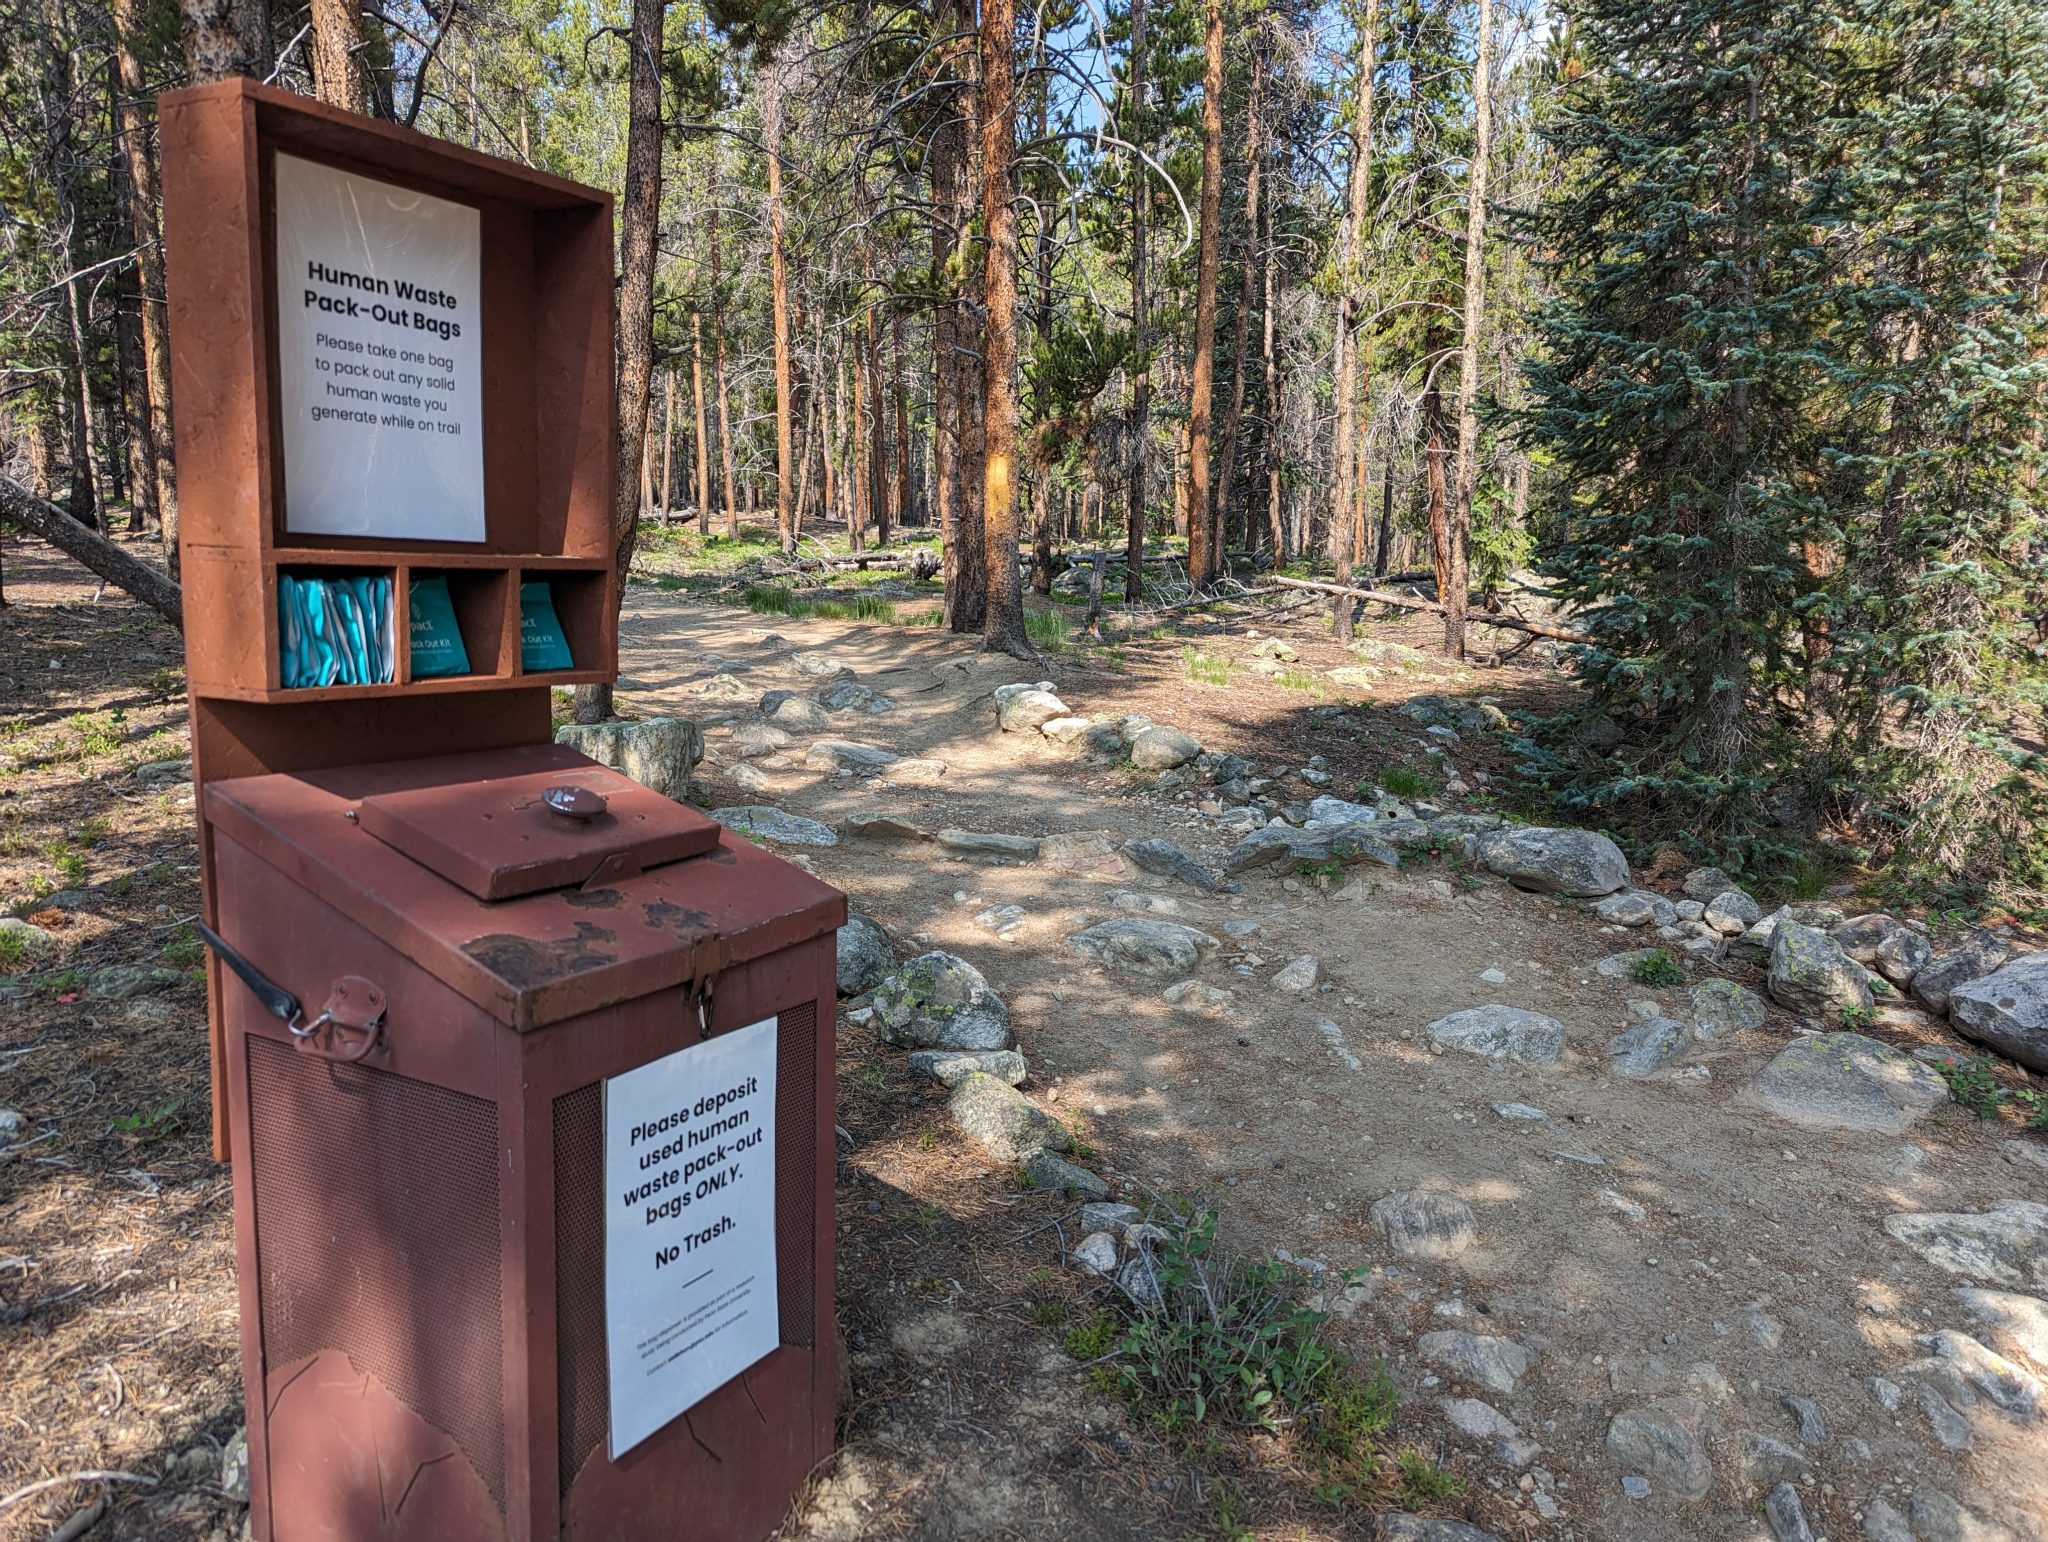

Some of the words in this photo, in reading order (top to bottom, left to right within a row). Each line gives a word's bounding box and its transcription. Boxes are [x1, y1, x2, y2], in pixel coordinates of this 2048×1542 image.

[308, 261, 389, 296] Human
[394, 280, 457, 309] Waste
[304, 290, 409, 327] Pack-Out
[414, 312, 461, 340] Bags
[315, 358, 330, 371] to
[334, 361, 369, 377] pack
[373, 369, 395, 382] out
[399, 373, 423, 389] any
[426, 376, 455, 391] solid
[316, 333, 363, 353] Please
[367, 343, 397, 359] take
[400, 350, 425, 364] one
[429, 353, 454, 372] bag
[311, 406, 377, 424] generate
[381, 415, 415, 429] while
[418, 419, 434, 432] on
[438, 421, 461, 435] trail
[326, 382, 378, 401] human
[381, 391, 421, 408] waste
[424, 399, 447, 412] you
[630, 1108, 689, 1147] Please
[693, 1077, 758, 1118] deposit
[639, 1134, 684, 1170] used
[688, 1109, 749, 1149] human
[623, 1170, 680, 1207] waste
[684, 1127, 763, 1184] pack-out
[646, 1191, 691, 1226] bags
[696, 1163, 743, 1200] ONLY.
[655, 1245, 680, 1269] No
[683, 1215, 736, 1253] Trash.
